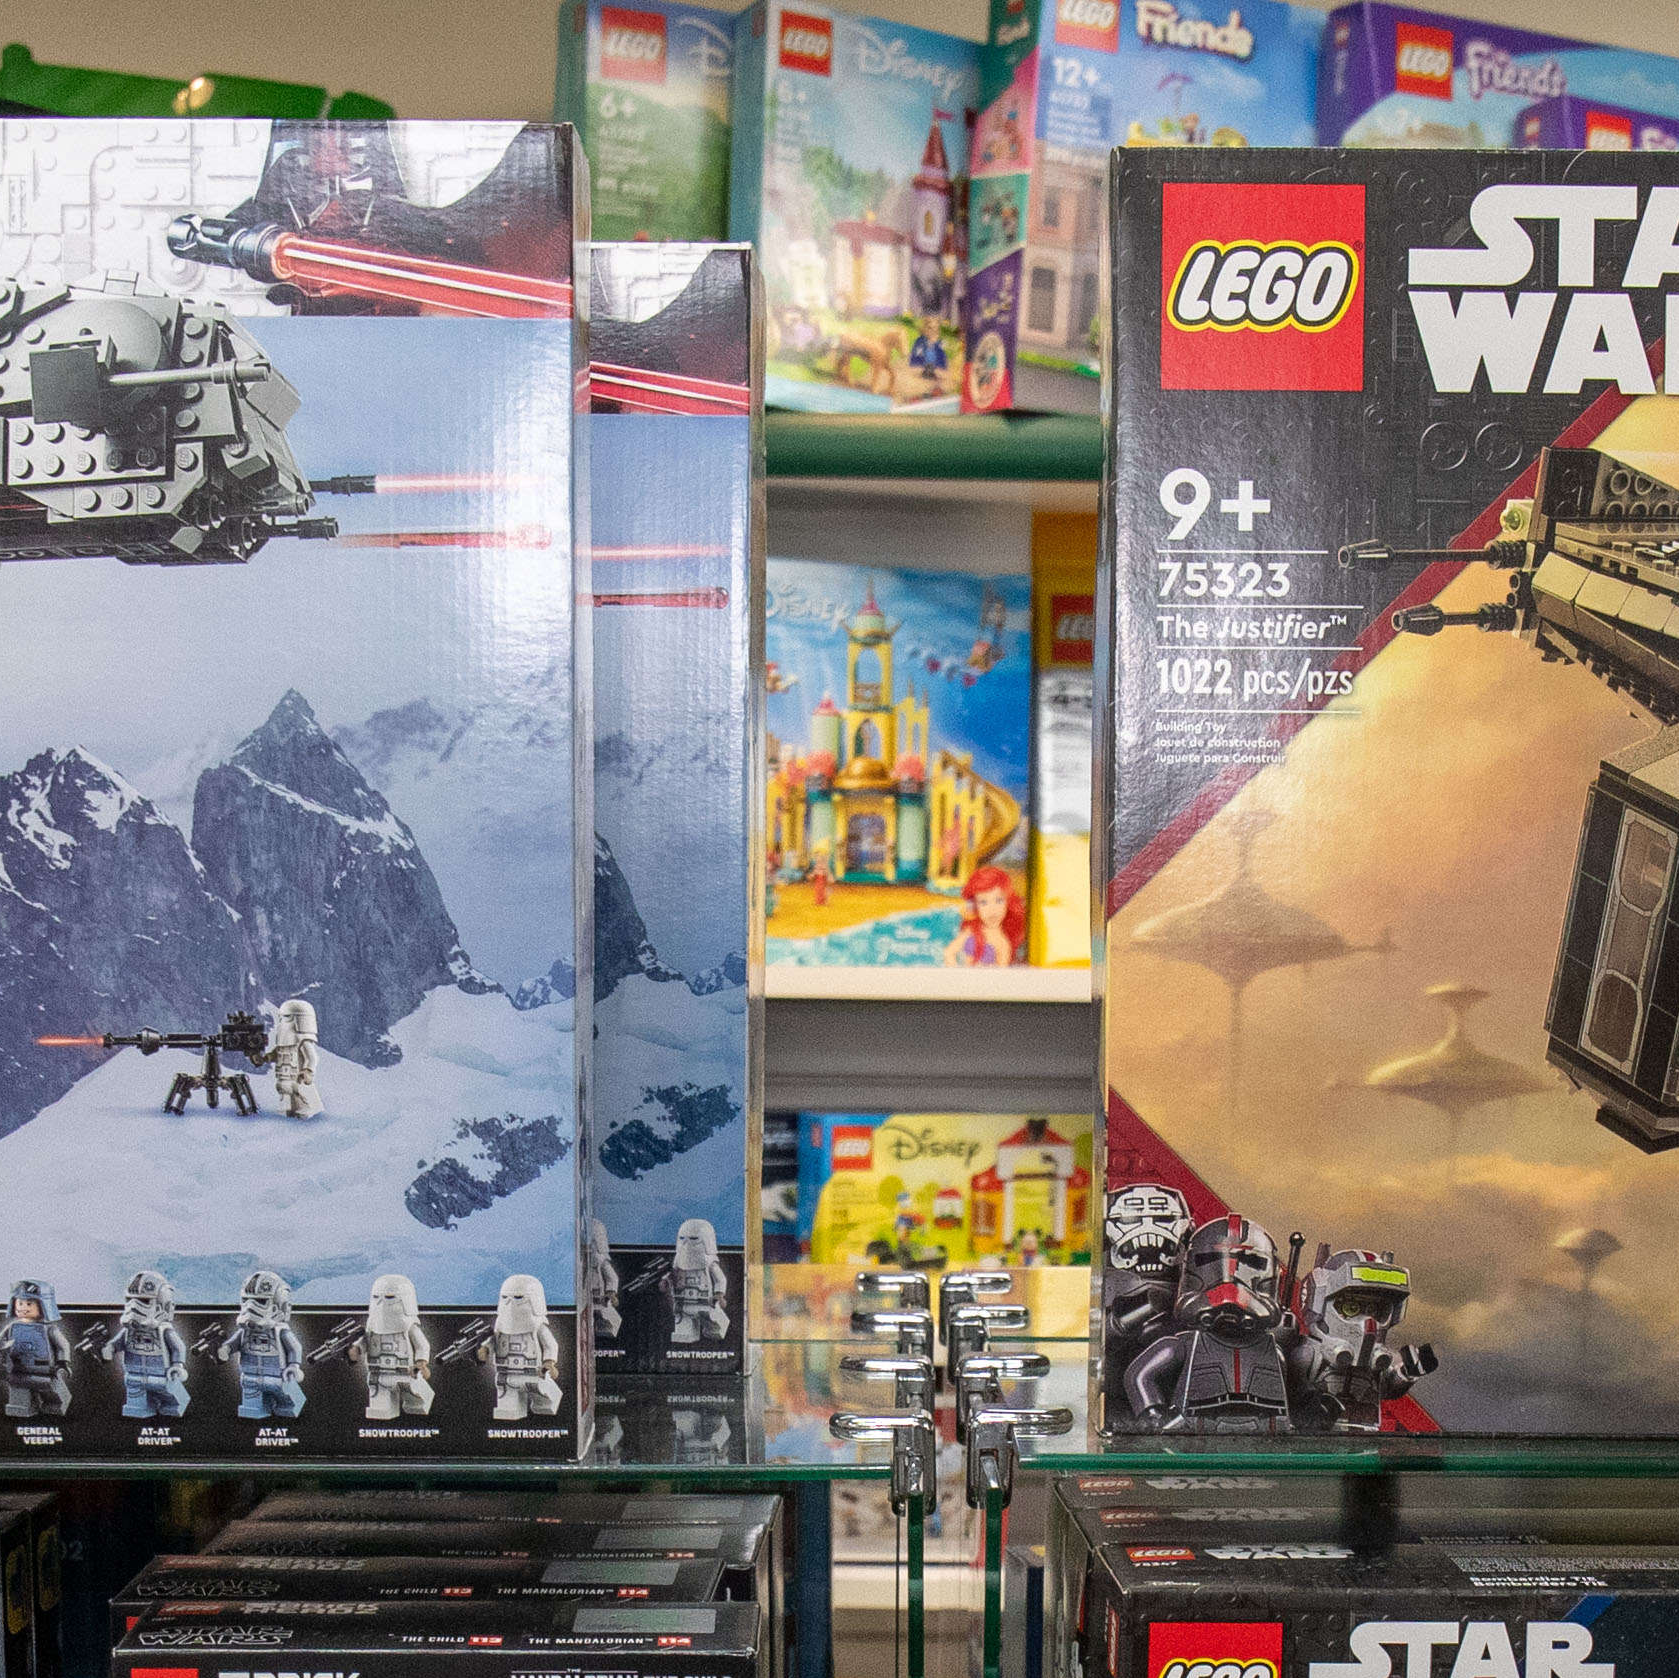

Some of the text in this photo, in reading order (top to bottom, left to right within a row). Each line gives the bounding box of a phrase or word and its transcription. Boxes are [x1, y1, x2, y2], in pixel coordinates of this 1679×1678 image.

[1136, 3, 1255, 58] Friends
[1174, 244, 1352, 328] LEGO
[1159, 467, 1271, 540] 9+
[1158, 562, 1291, 597] 75323
[1156, 616, 1208, 639] The
[1156, 657, 1354, 701] 1022 pcs/pzs
[17, 1427, 61, 1436] GENERAL
[141, 1428, 170, 1436] AT-AT
[259, 1428, 288, 1437] AT-AT
